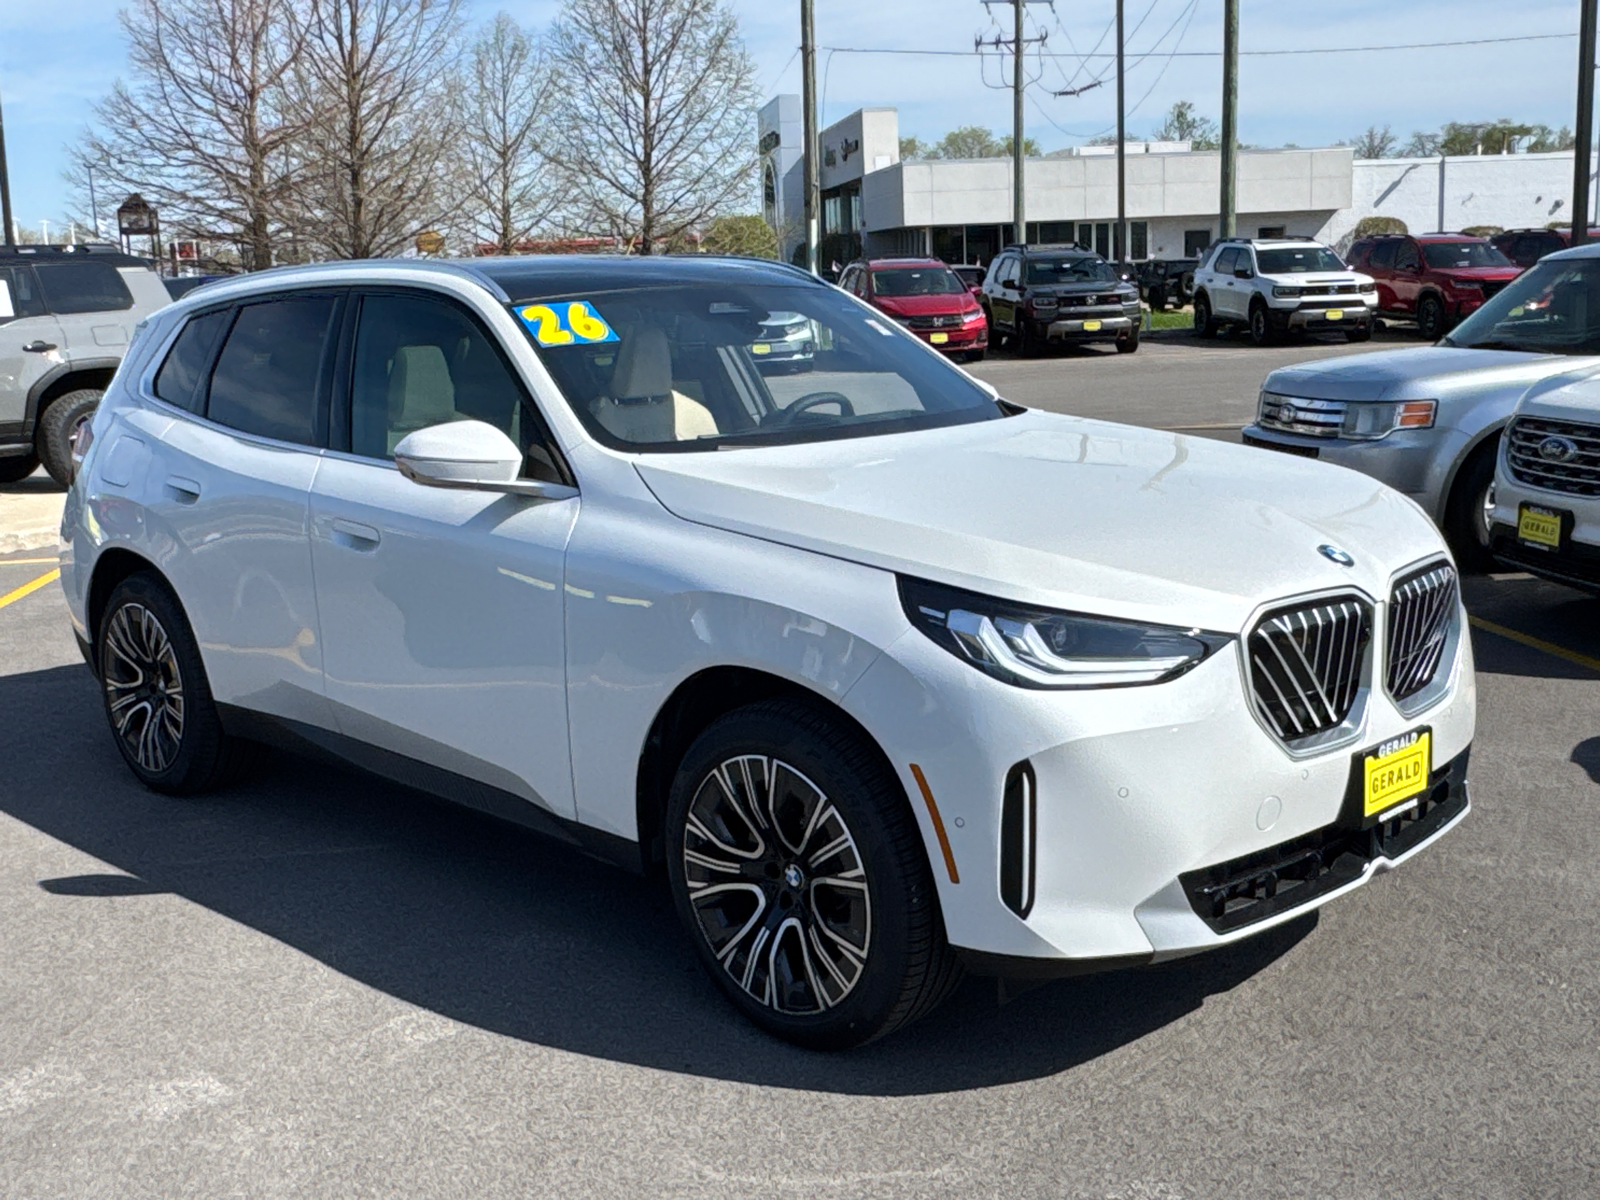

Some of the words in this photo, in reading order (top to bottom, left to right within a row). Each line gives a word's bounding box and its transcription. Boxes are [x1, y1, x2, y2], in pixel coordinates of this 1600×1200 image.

[521, 303, 609, 345] 26
[1378, 732, 1418, 759] GERALD
[1372, 761, 1420, 794] GERALD
